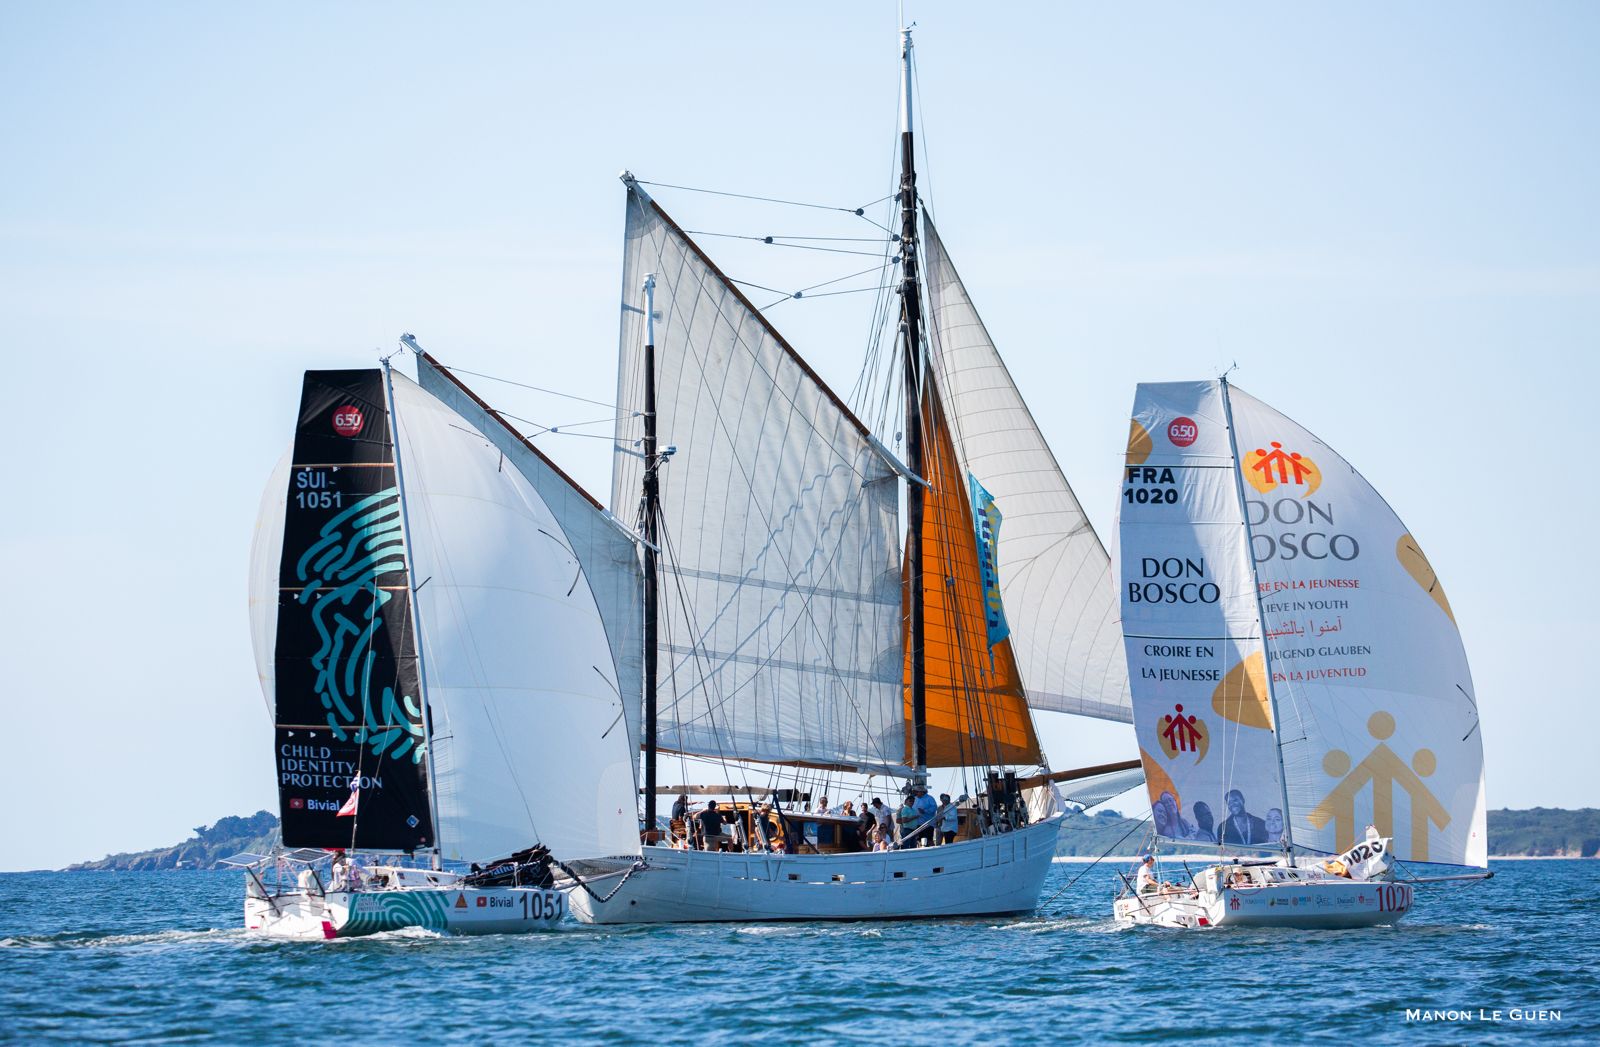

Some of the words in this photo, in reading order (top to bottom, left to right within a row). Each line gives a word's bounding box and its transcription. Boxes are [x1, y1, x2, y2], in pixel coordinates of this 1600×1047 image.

[1128, 467, 1175, 484] FRA
[296, 491, 342, 508] 1051
[1124, 488, 1178, 504] 1020
[1246, 498, 1334, 525] DON
[1251, 532, 1360, 563] OSCO
[1142, 557, 1204, 578] DON
[1128, 582, 1220, 604] BOSCO
[1274, 581, 1289, 591] EN
[1292, 580, 1306, 590] LA
[1309, 579, 1360, 590] JEUNESSE
[1293, 601, 1306, 611] IN
[1307, 600, 1349, 610] YOUTH
[1144, 644, 1192, 657] CROIRE
[1196, 646, 1214, 658] EN
[1269, 647, 1315, 661] JUGEND
[1318, 645, 1371, 657] GLAUBEN
[1141, 667, 1156, 679] LA
[1160, 668, 1220, 681] JEUNESSE
[1273, 671, 1287, 683] EN
[1290, 670, 1303, 681] LA
[1306, 667, 1367, 681] JUVENTUD
[281, 744, 331, 759] CHILD
[281, 758, 356, 774] IDENTITY
[282, 773, 383, 788] PROTECTON
[307, 799, 340, 811] Bivial
[490, 896, 514, 908] Bivial
[519, 892, 562, 920] 1051
